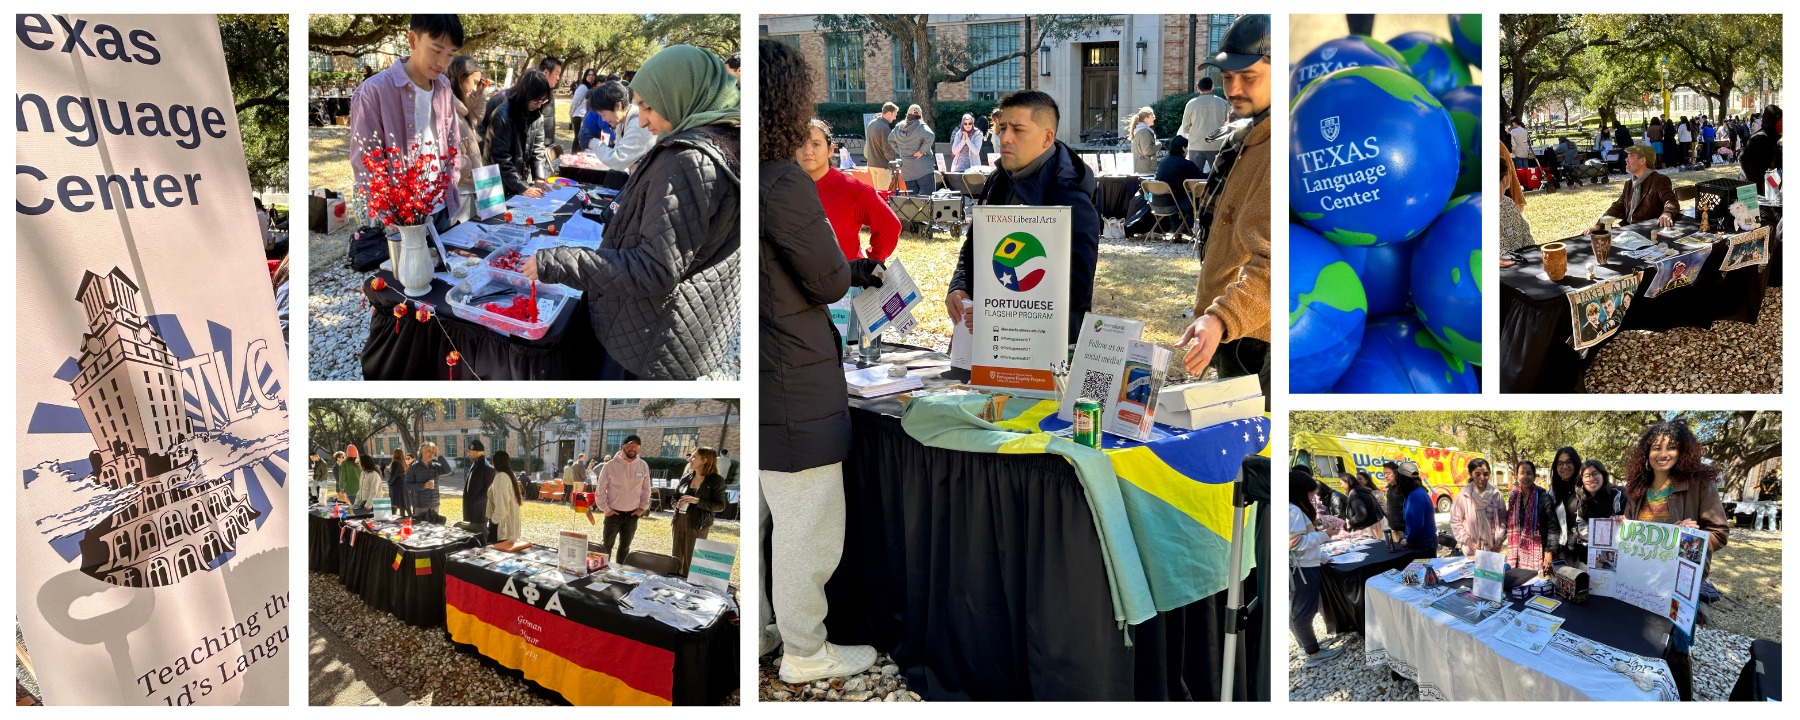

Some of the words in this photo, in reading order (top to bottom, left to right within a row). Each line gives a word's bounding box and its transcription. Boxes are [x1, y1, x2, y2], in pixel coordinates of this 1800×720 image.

[1299, 60, 1358, 82] TEXA
[16, 93, 227, 149] nguage
[1297, 136, 1380, 174] TEXAS
[1302, 164, 1386, 193] Language
[16, 165, 202, 215] Center
[1320, 188, 1380, 211] Center
[986, 215, 1013, 223] TEXAS
[1039, 216, 1057, 224] Arts
[984, 298, 1054, 310] PORTUGUESE
[984, 310, 1018, 318] FLAGSHIP
[1018, 311, 1053, 319] PROGRAM
[1088, 339, 1107, 350] Follow
[1084, 352, 1101, 361] social
[1101, 355, 1122, 366] media!
[178, 338, 280, 433] TLC
[1353, 453, 1416, 467] Wete'
[137, 612, 261, 697] Teaching
